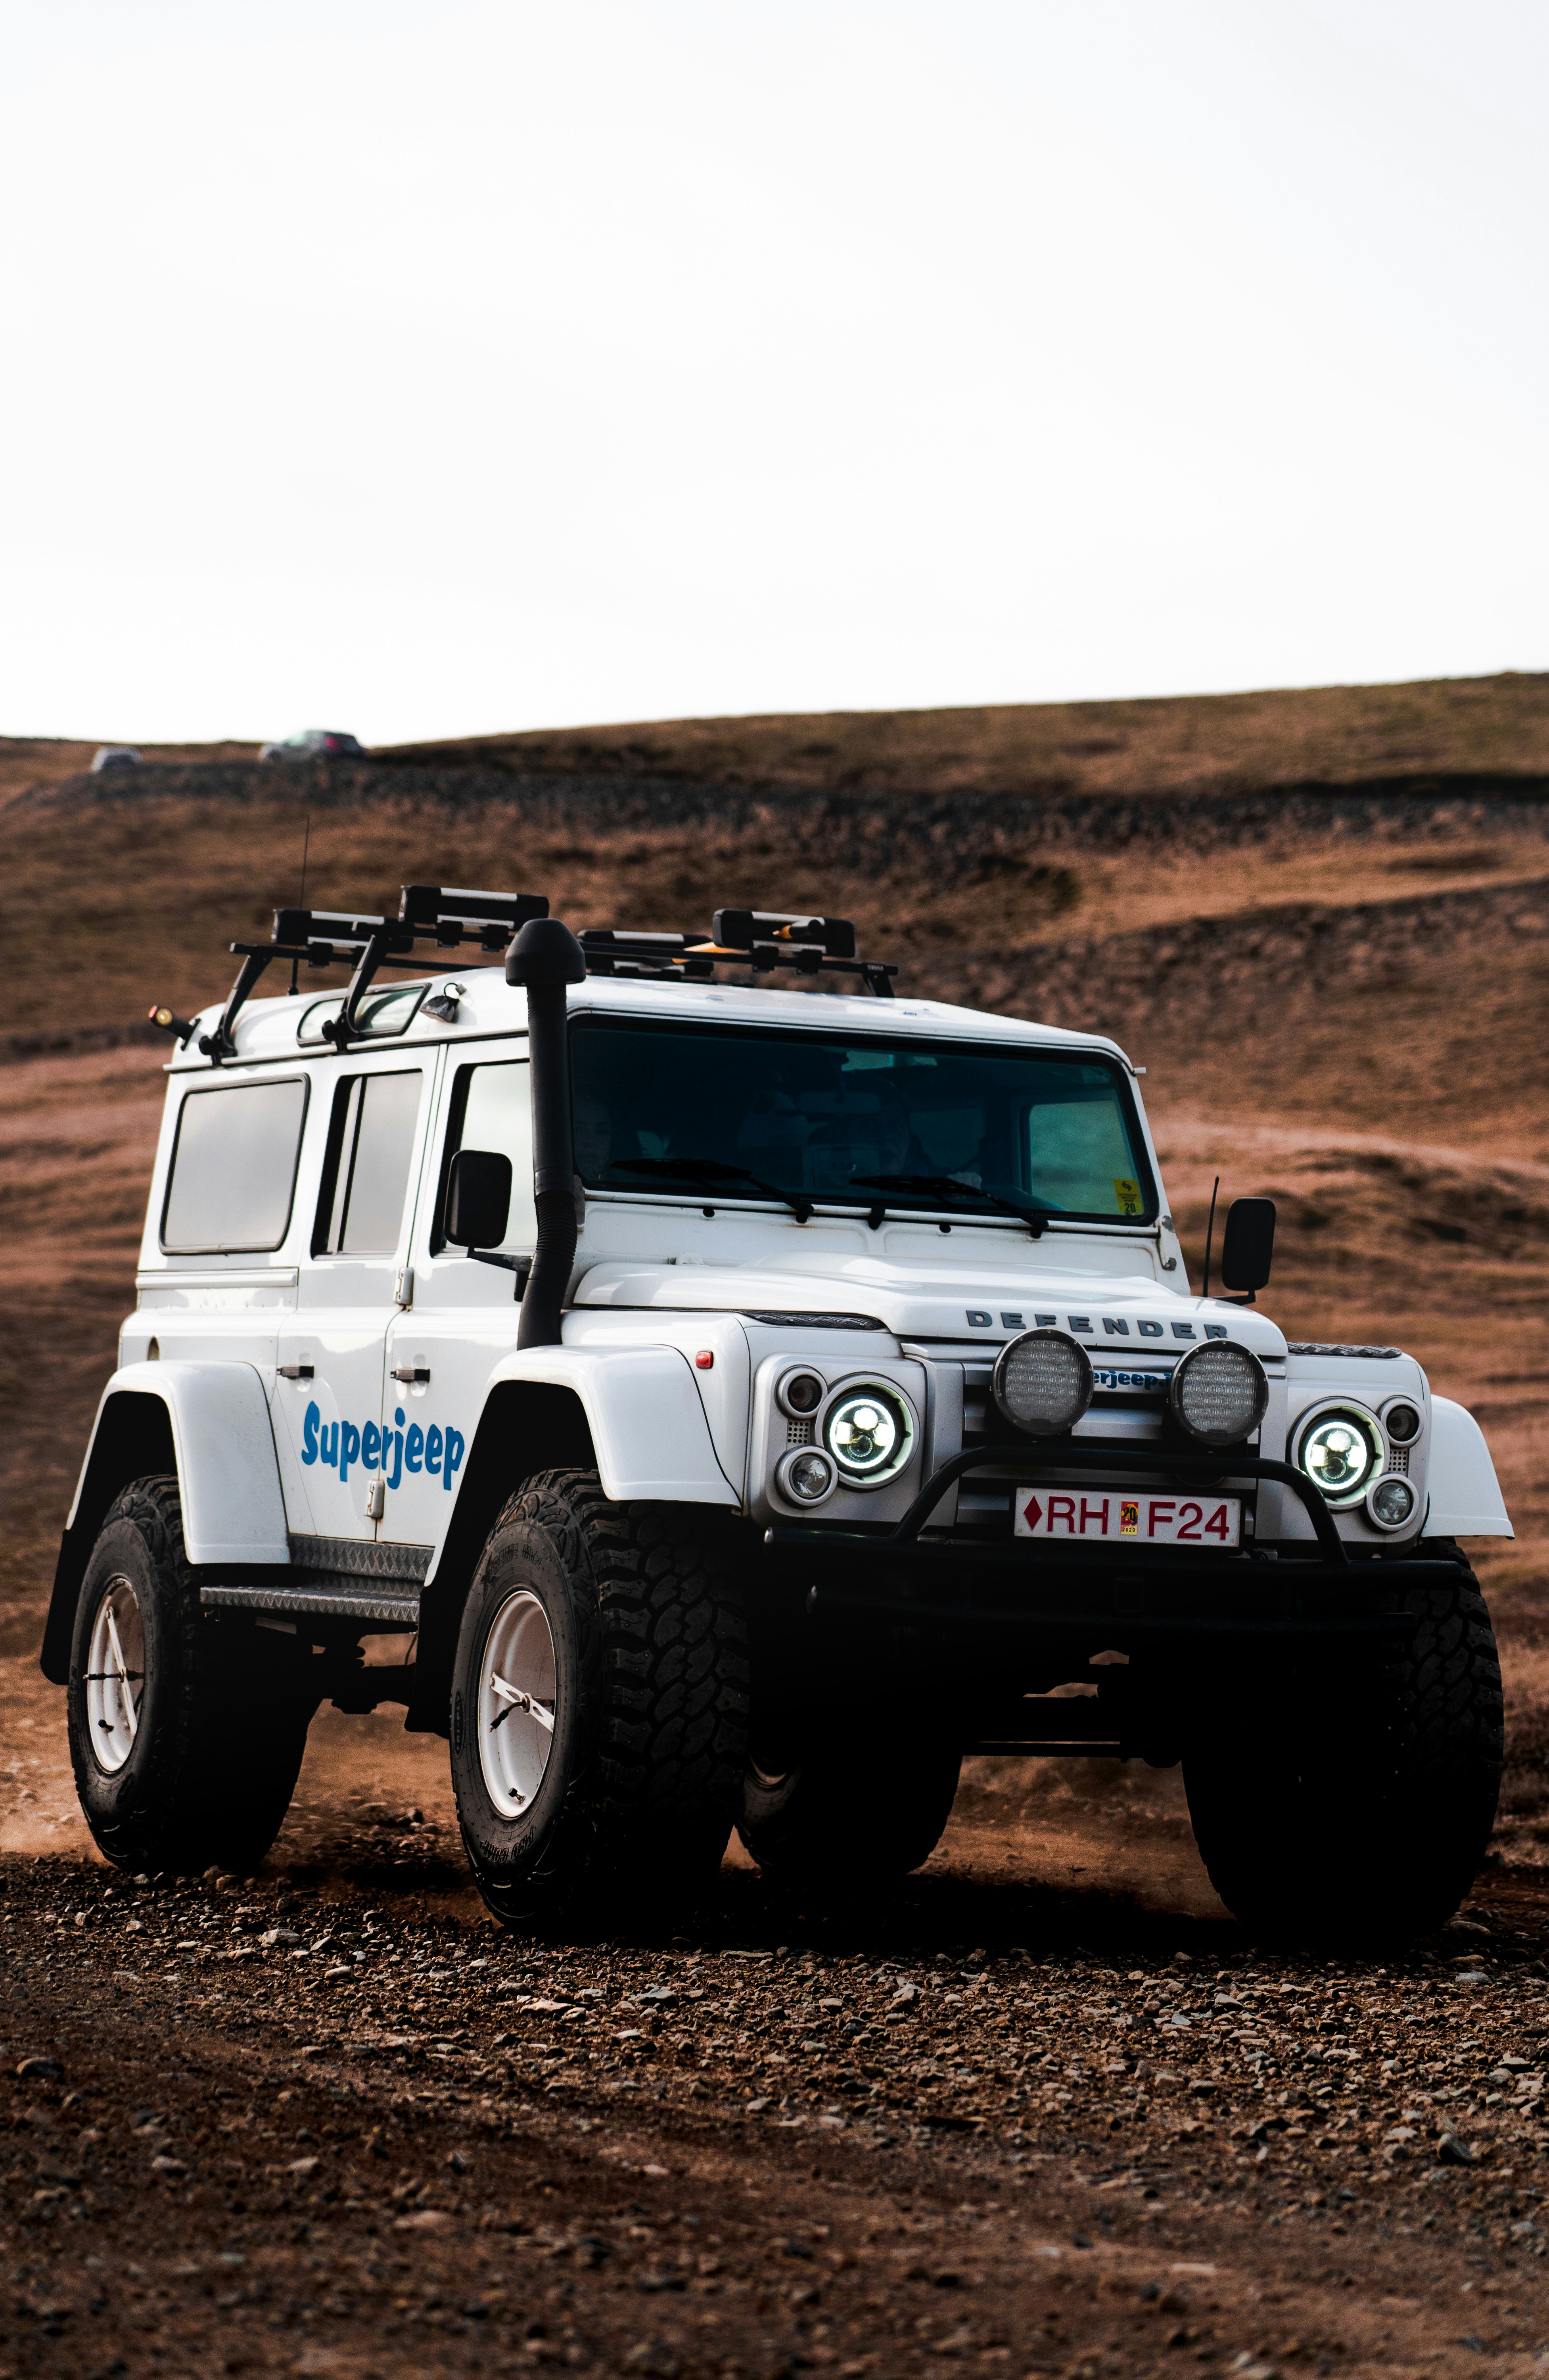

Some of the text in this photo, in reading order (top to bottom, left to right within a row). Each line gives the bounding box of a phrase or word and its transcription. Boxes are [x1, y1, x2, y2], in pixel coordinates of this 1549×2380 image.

[1125, 1203, 1136, 1212] 20
[966, 1310, 1228, 1340] DEFENDER
[301, 1401, 465, 1491] Superjeep
[1047, 1496, 1229, 1541] RH F24
[1123, 1507, 1136, 1521] 20
